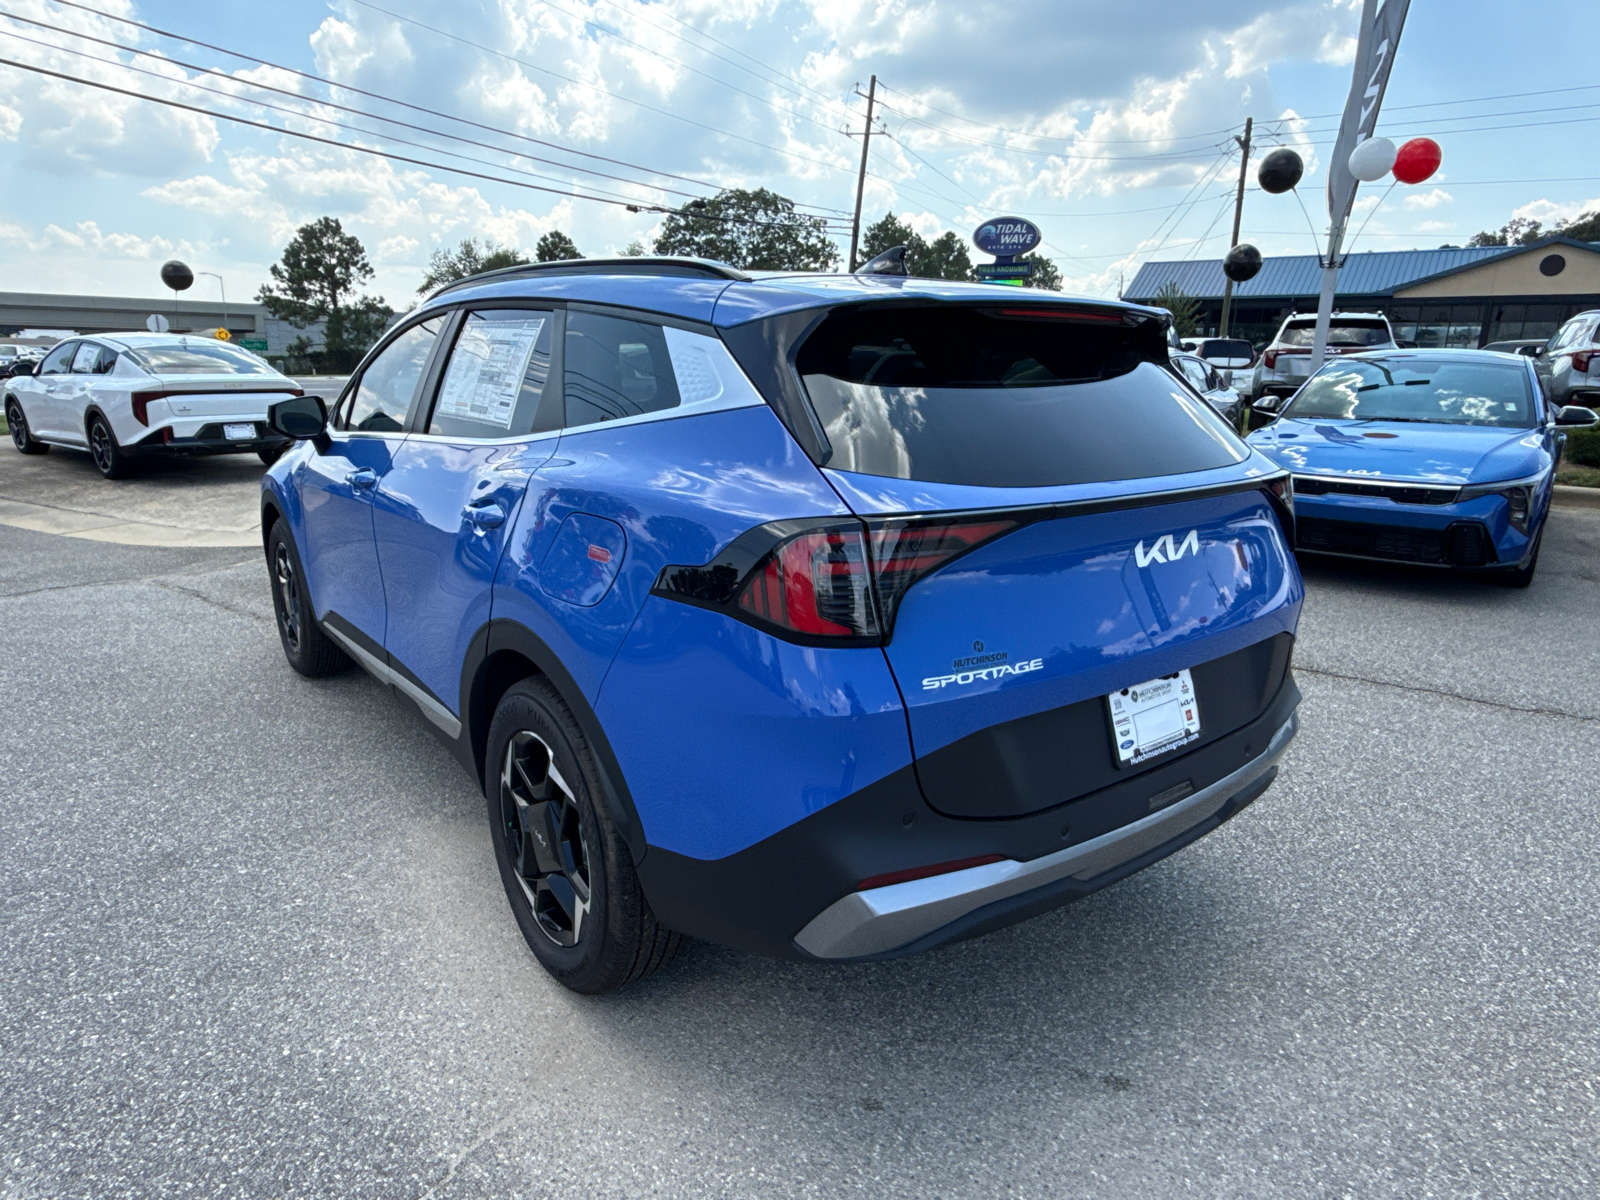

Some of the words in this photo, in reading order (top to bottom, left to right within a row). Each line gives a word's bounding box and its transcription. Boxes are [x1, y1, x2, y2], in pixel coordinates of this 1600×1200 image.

[996, 224, 1027, 233] TIDAL
[1000, 234, 1033, 244] WAVE
[996, 265, 1027, 273] VACUUMS
[1134, 529, 1199, 568] KIA
[953, 652, 1008, 668] HUTCHINSON
[922, 658, 1044, 690] SPORTAGE
[1139, 682, 1172, 697] HUTCHINSON
[1115, 716, 1130, 726] GMC
